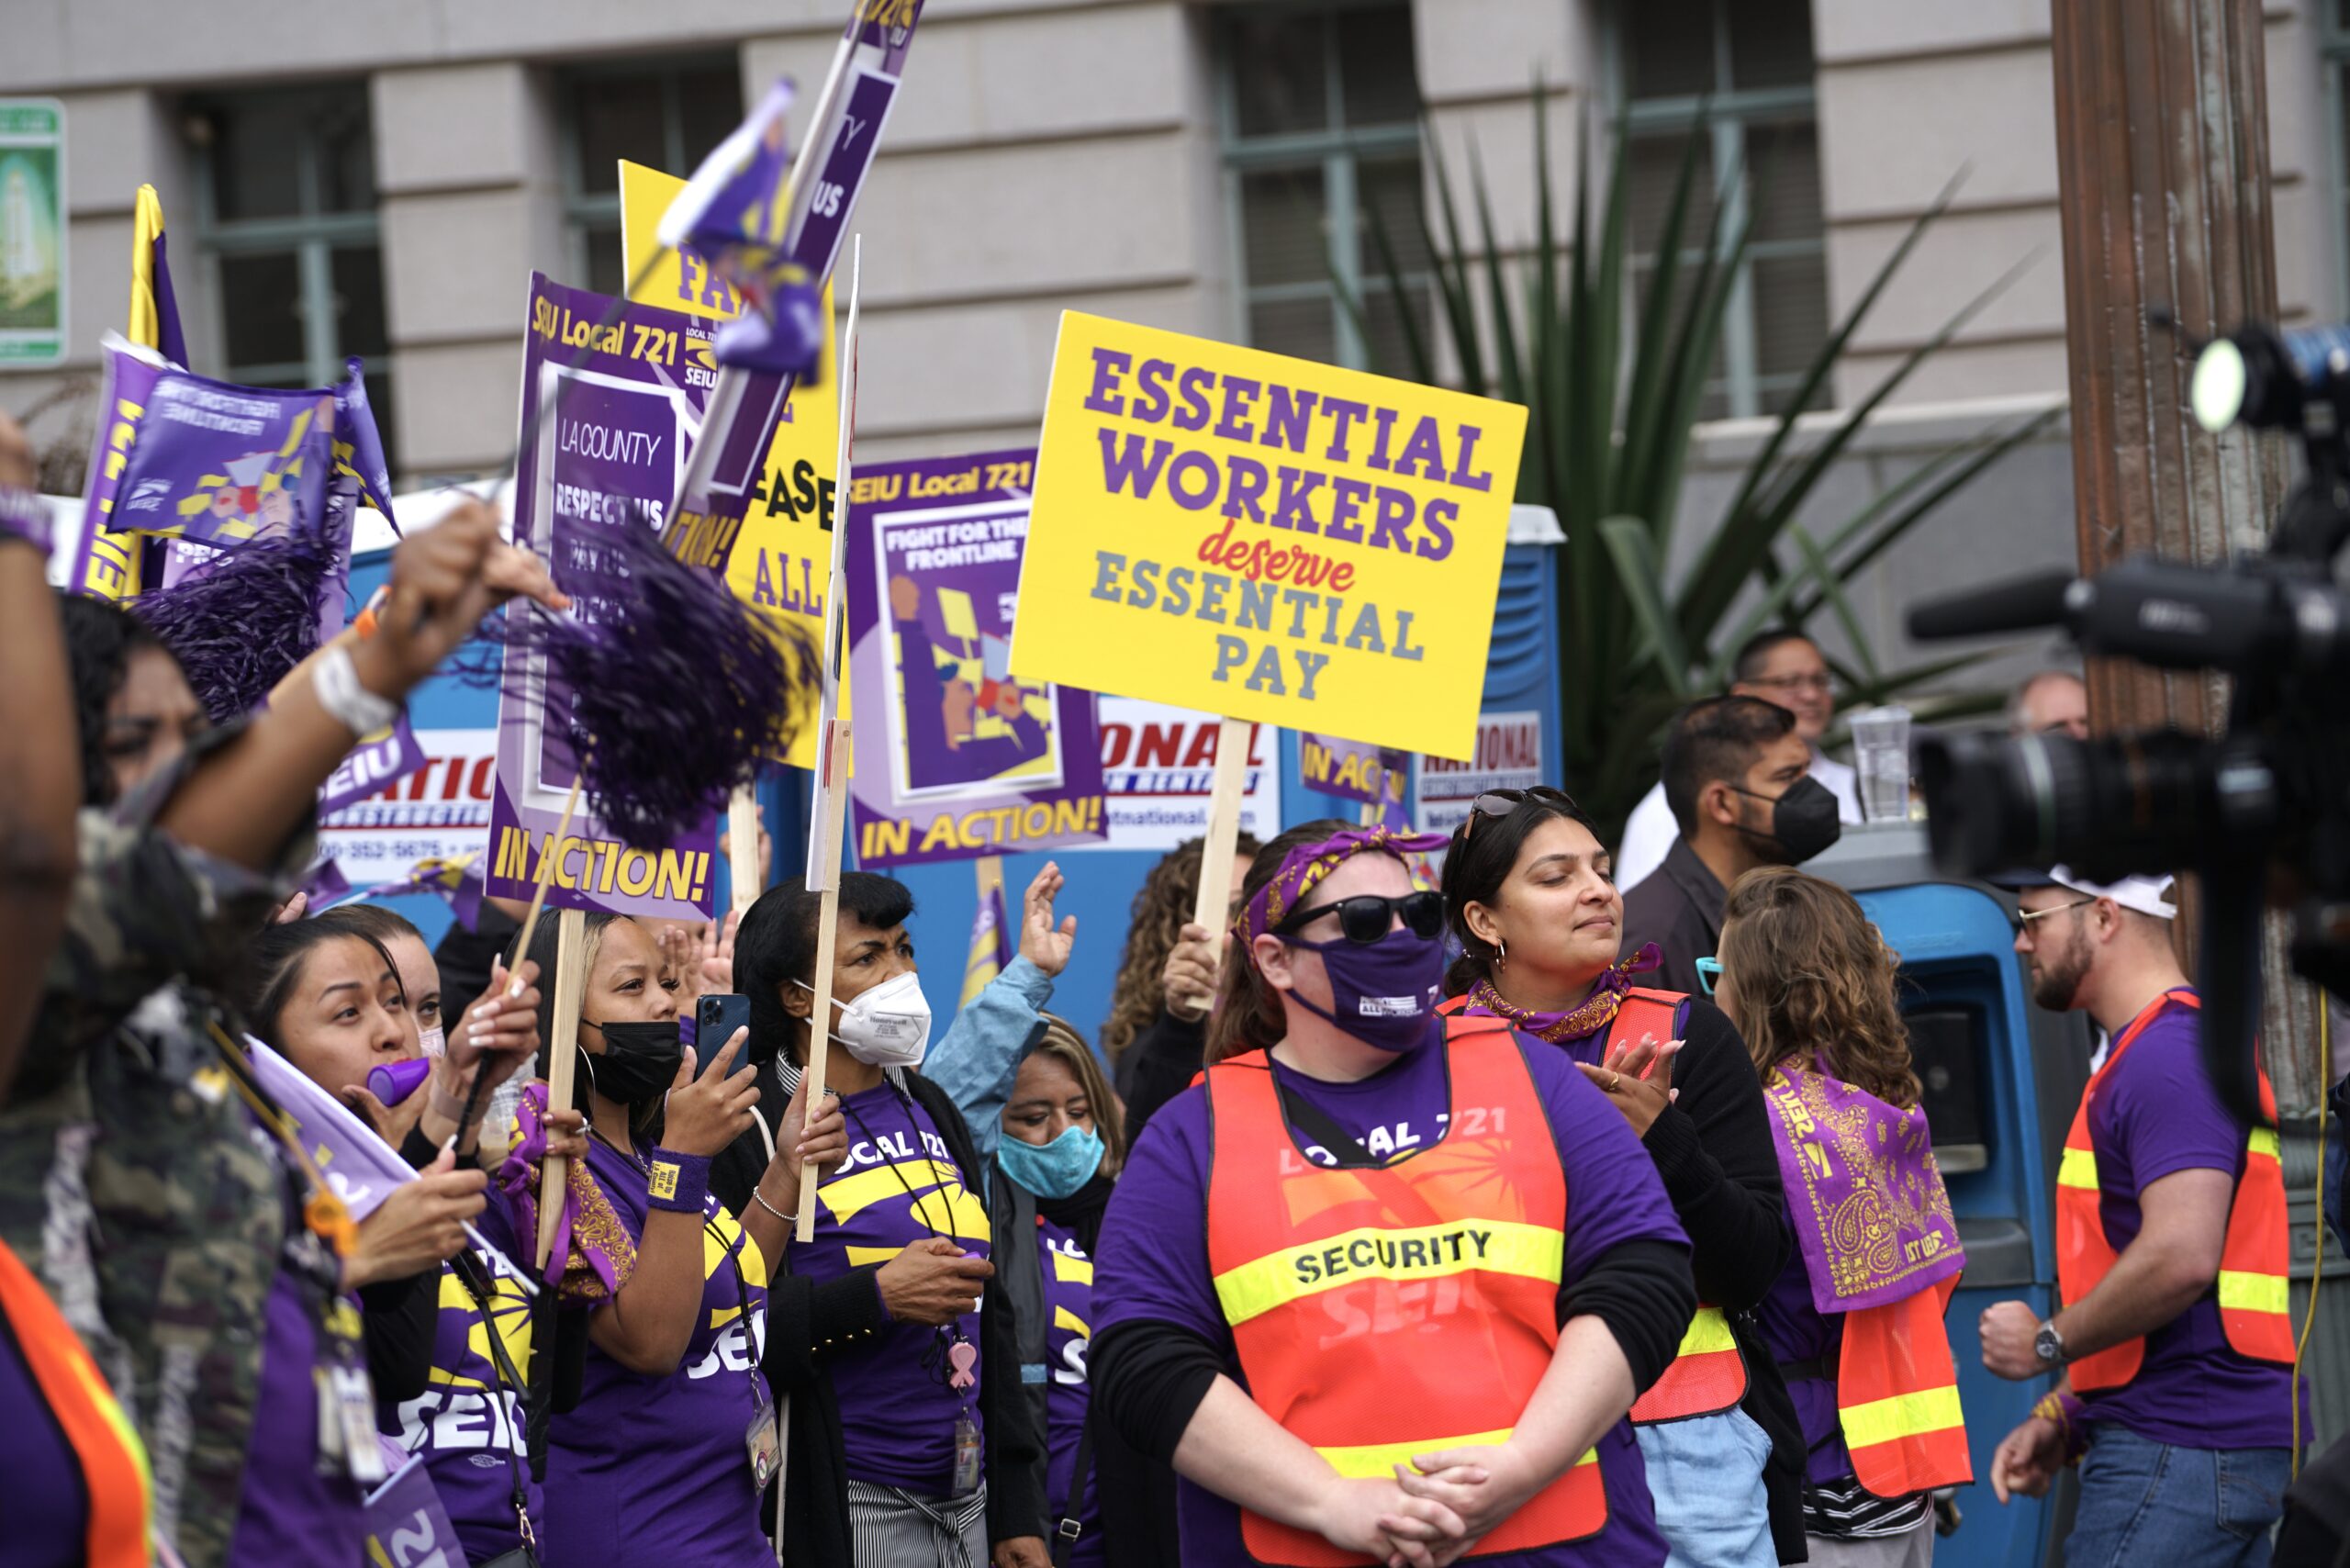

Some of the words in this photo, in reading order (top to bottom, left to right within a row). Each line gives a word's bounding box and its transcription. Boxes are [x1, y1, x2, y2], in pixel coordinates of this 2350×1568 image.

[561, 308, 627, 356] Local
[631, 324, 678, 365] 721
[686, 327, 706, 341] LOCAL
[685, 367, 717, 387] SEIU
[561, 418, 578, 454] LA
[579, 423, 662, 466] COUNTY
[1083, 346, 1494, 492] ESSENTIAL
[909, 466, 979, 499] Local
[985, 461, 1033, 489] 721
[1097, 427, 1460, 562] WORKERS
[886, 524, 947, 552] FIGHT
[948, 521, 990, 545] FOR
[905, 539, 1019, 572] FRONTLINE
[1197, 517, 1356, 592] deserve
[753, 547, 823, 618] ALL
[1090, 550, 1425, 661] ESSENTIAL
[1212, 633, 1329, 700] PAY
[1101, 722, 1264, 768] ONAL
[860, 818, 910, 859] IN
[921, 795, 1103, 853] ACTION!
[493, 825, 531, 881] IN
[532, 832, 711, 902] ACTION!
[1279, 1122, 1421, 1175] LOAL
[1295, 1228, 1492, 1284] SECURITY
